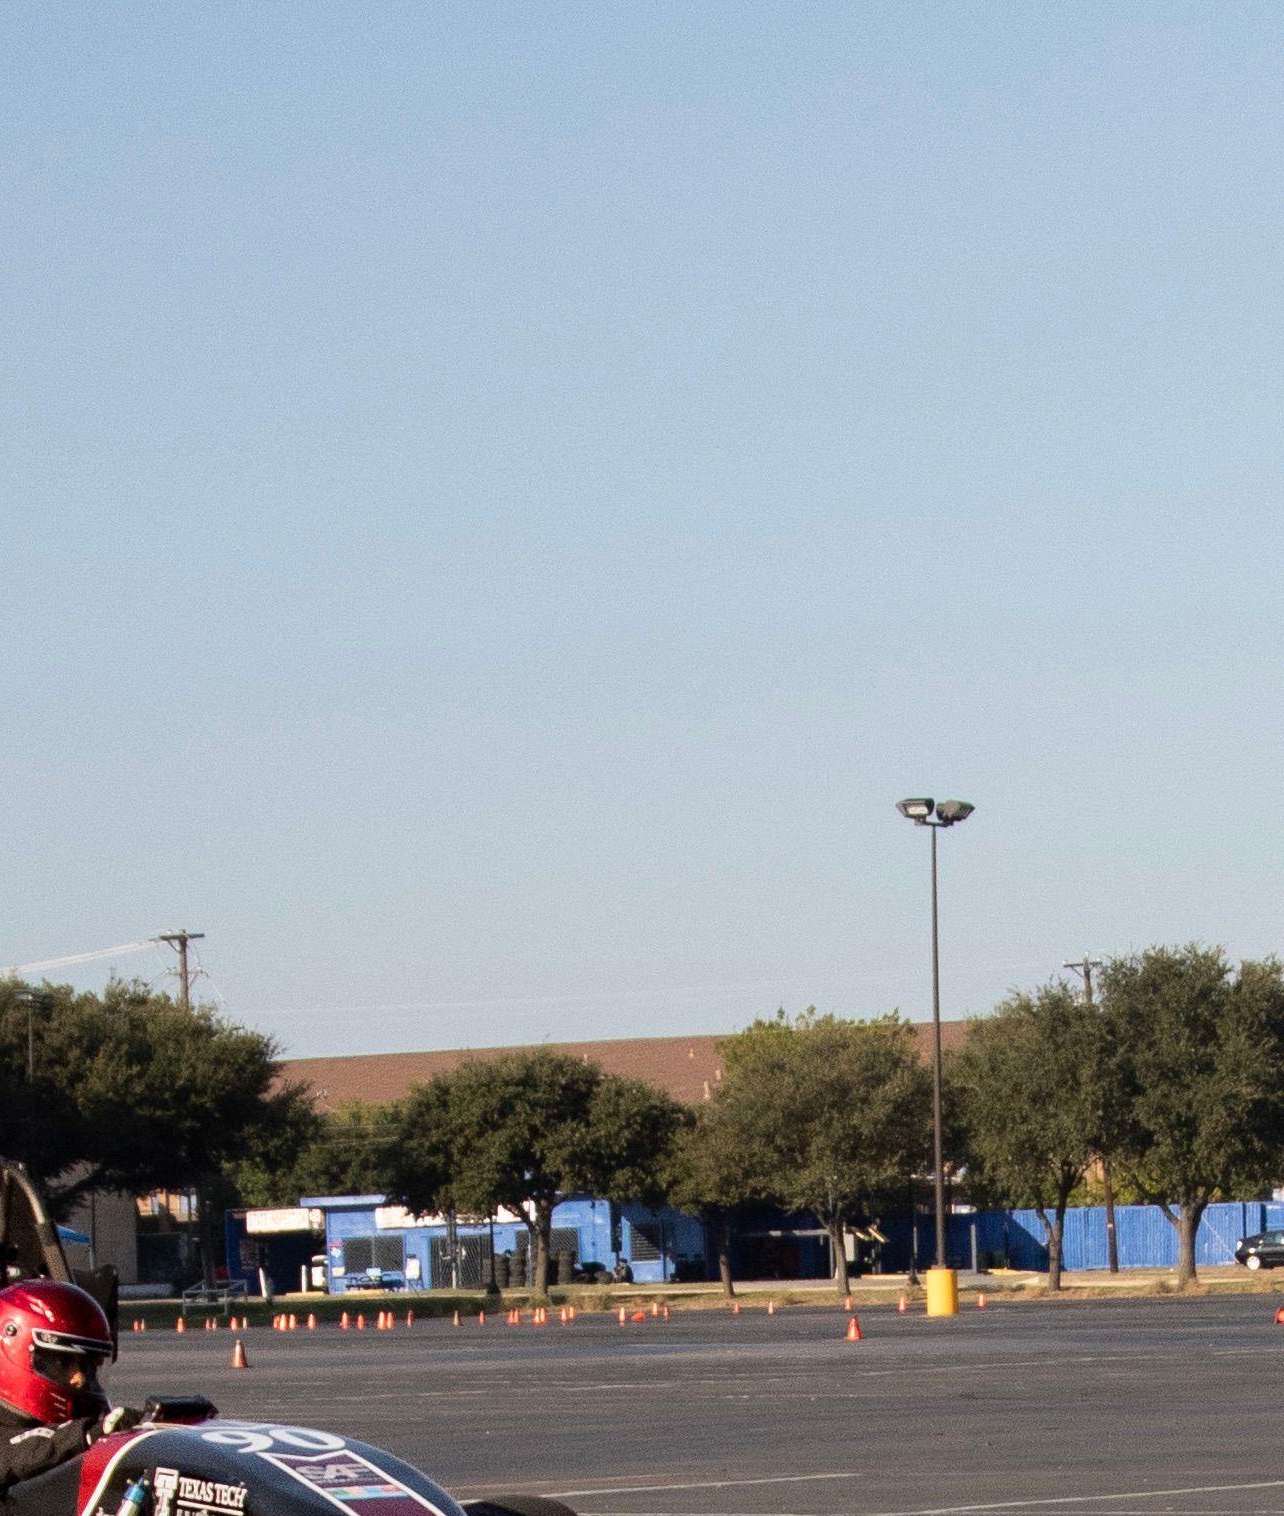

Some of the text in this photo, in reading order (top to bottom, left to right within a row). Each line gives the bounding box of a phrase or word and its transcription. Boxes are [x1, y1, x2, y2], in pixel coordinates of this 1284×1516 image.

[201, 1428, 346, 1453] 90
[179, 1477, 248, 1508] TEXAS TECH
